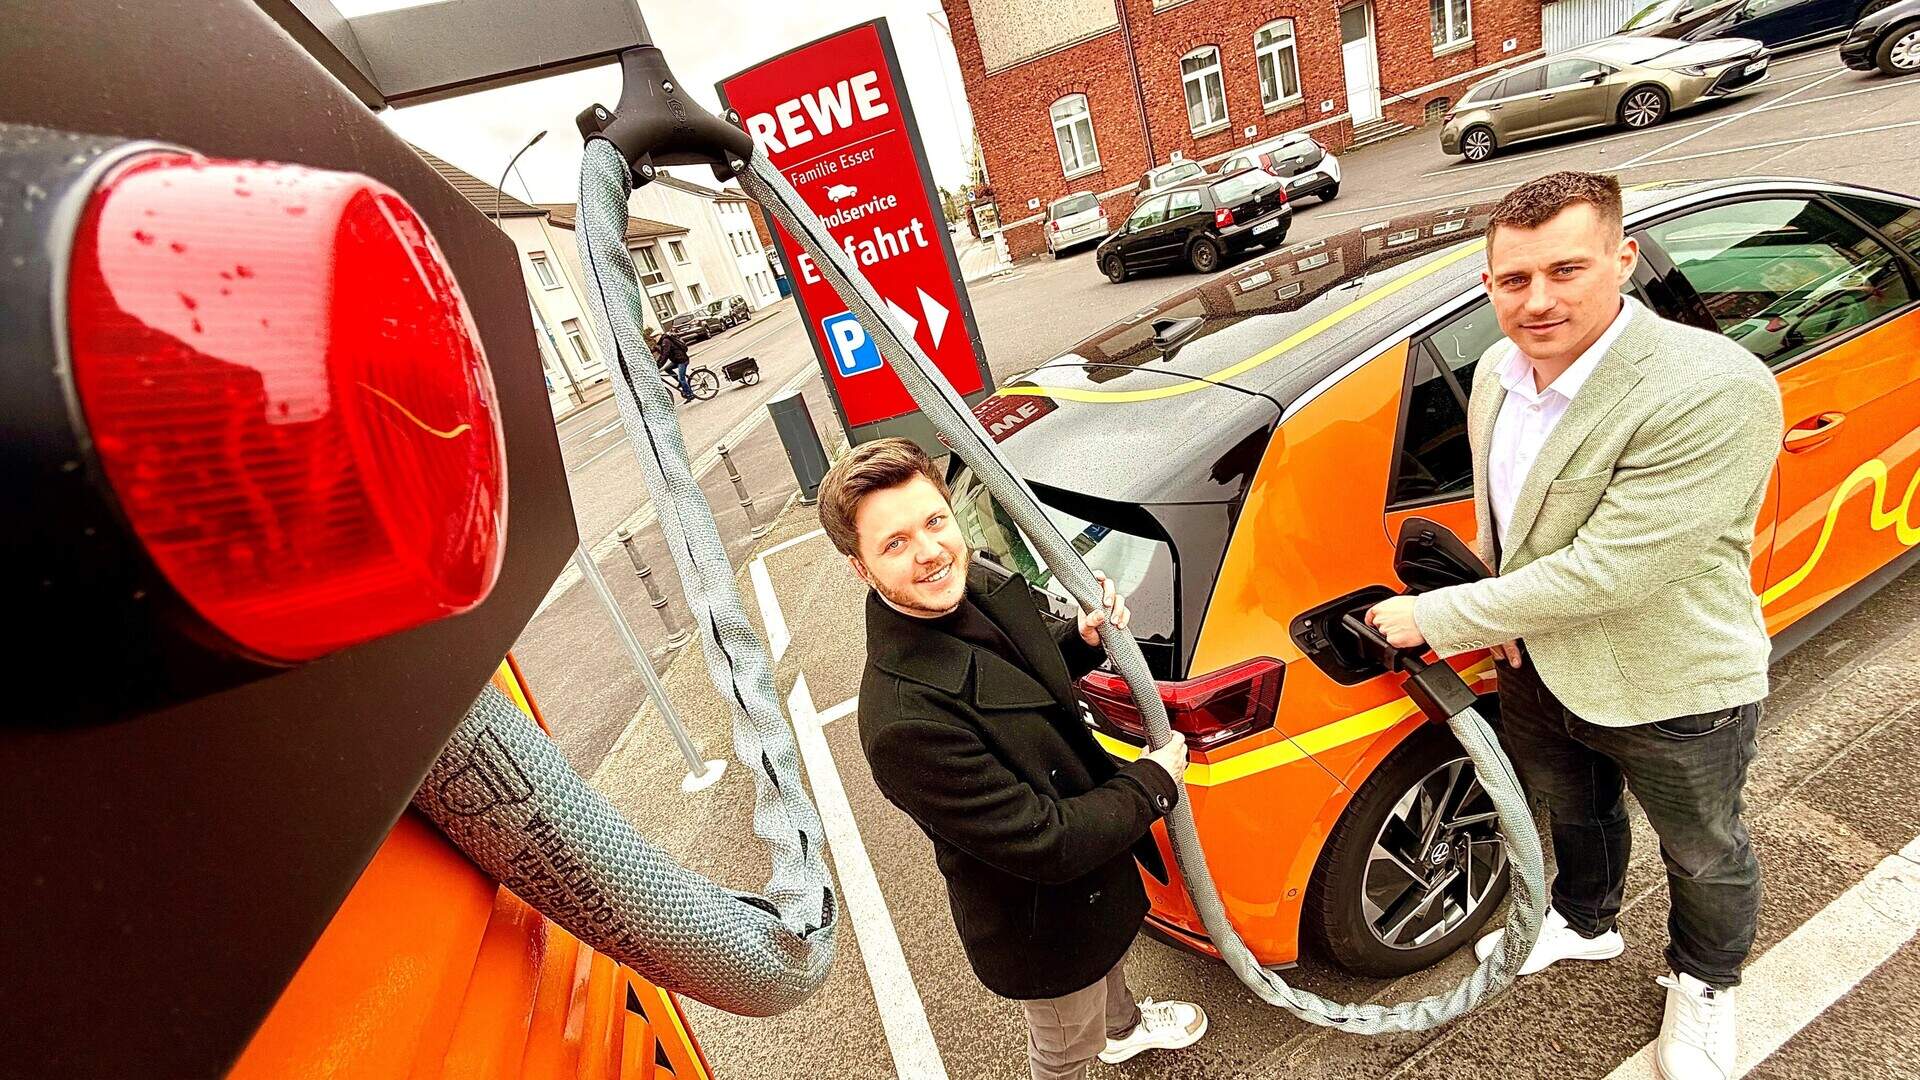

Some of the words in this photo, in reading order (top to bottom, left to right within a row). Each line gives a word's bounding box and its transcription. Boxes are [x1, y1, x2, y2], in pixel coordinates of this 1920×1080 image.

[746, 70, 889, 158] REWE
[791, 161, 838, 187] Familie
[840, 148, 875, 169] Esser
[819, 194, 898, 229] holservice
[797, 217, 929, 285] Efahrt
[831, 319, 866, 369] P
